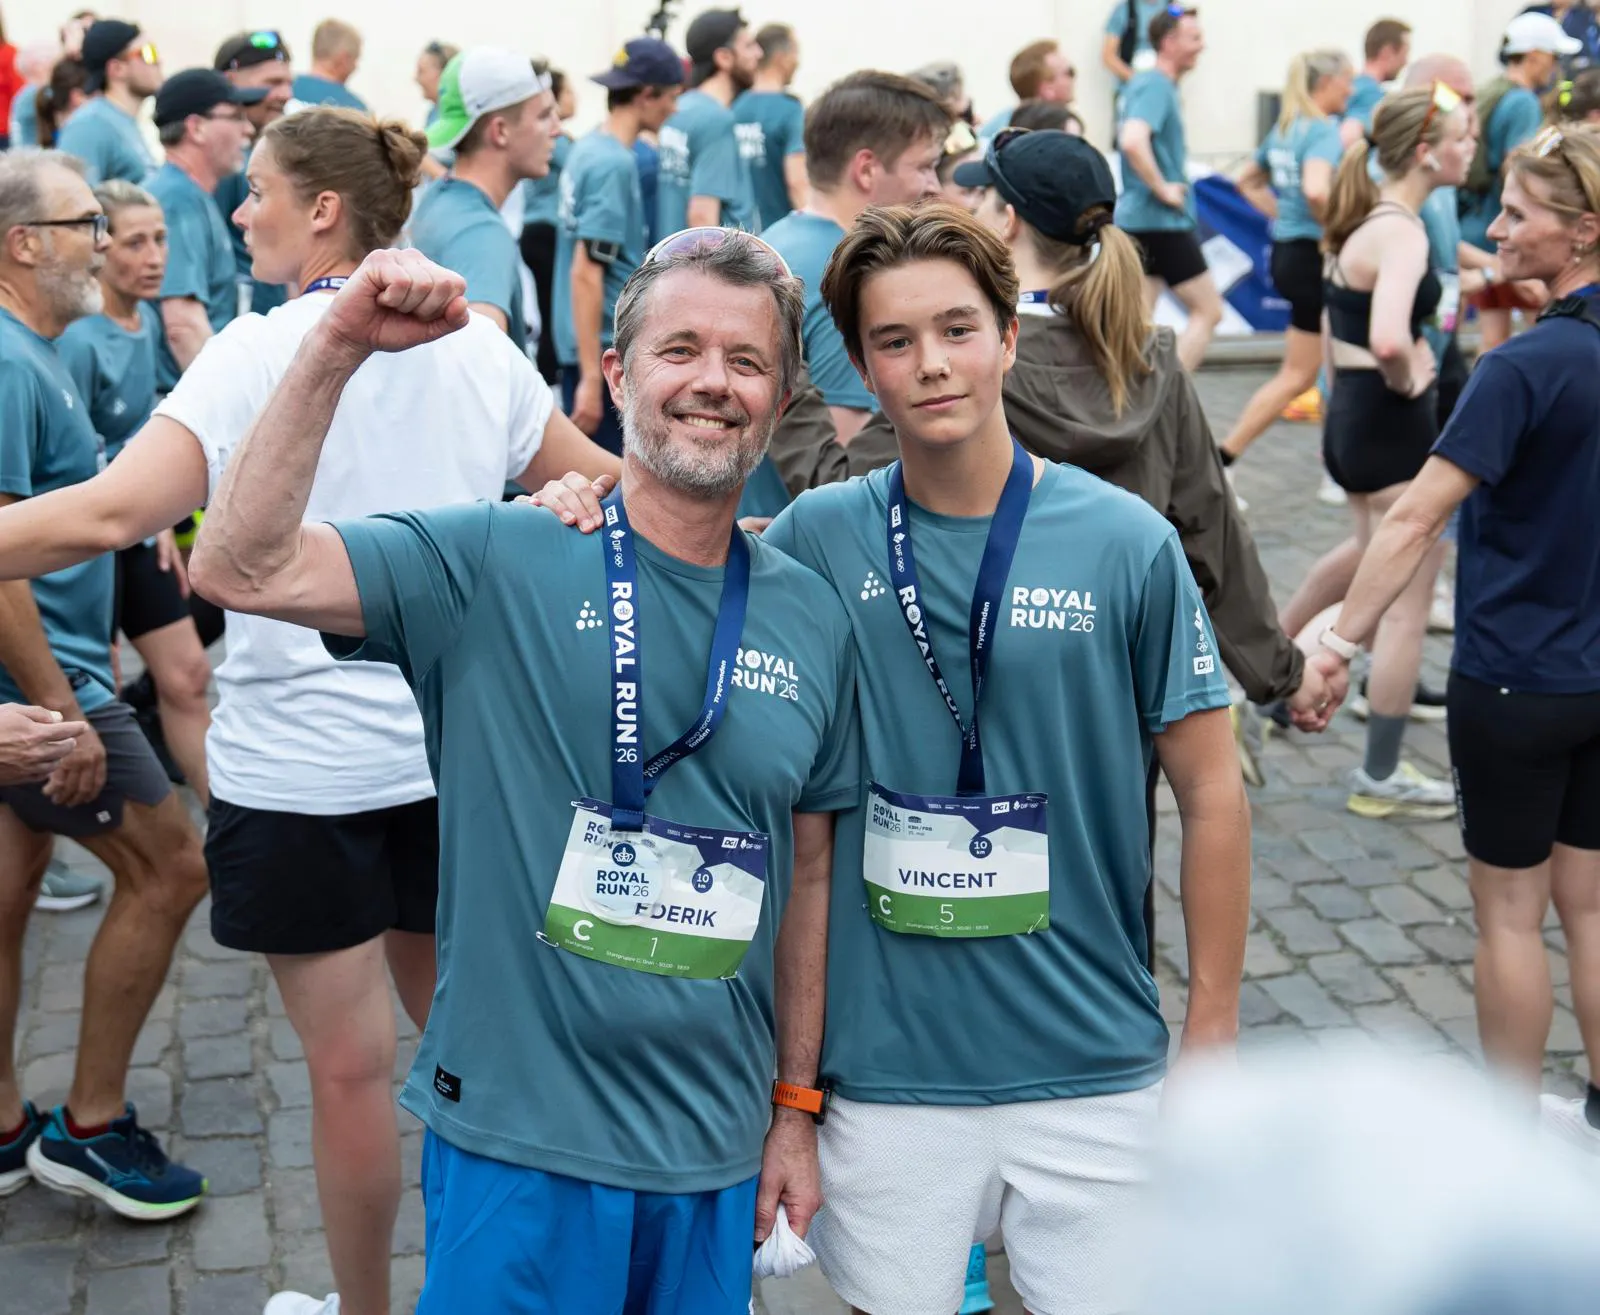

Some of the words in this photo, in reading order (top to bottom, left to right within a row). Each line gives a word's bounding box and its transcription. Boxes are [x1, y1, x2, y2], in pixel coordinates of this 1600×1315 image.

[612, 540, 622, 552] DIF
[1012, 586, 1097, 611] ROYAL
[612, 581, 635, 674] ROYAL
[899, 584, 935, 673] ROYAL
[976, 600, 990, 650] TrygFonden
[736, 648, 799, 682] ROYAL
[616, 681, 637, 743] RUN
[874, 803, 901, 822] ROYAL
[974, 841, 988, 850] 10
[597, 869, 649, 884] ROYAL
[696, 873, 710, 883] 10
[898, 868, 998, 889] VINCENT
[879, 894, 892, 915] C
[939, 903, 954, 924] 5
[573, 919, 594, 941] C
[651, 936, 658, 958] 1
